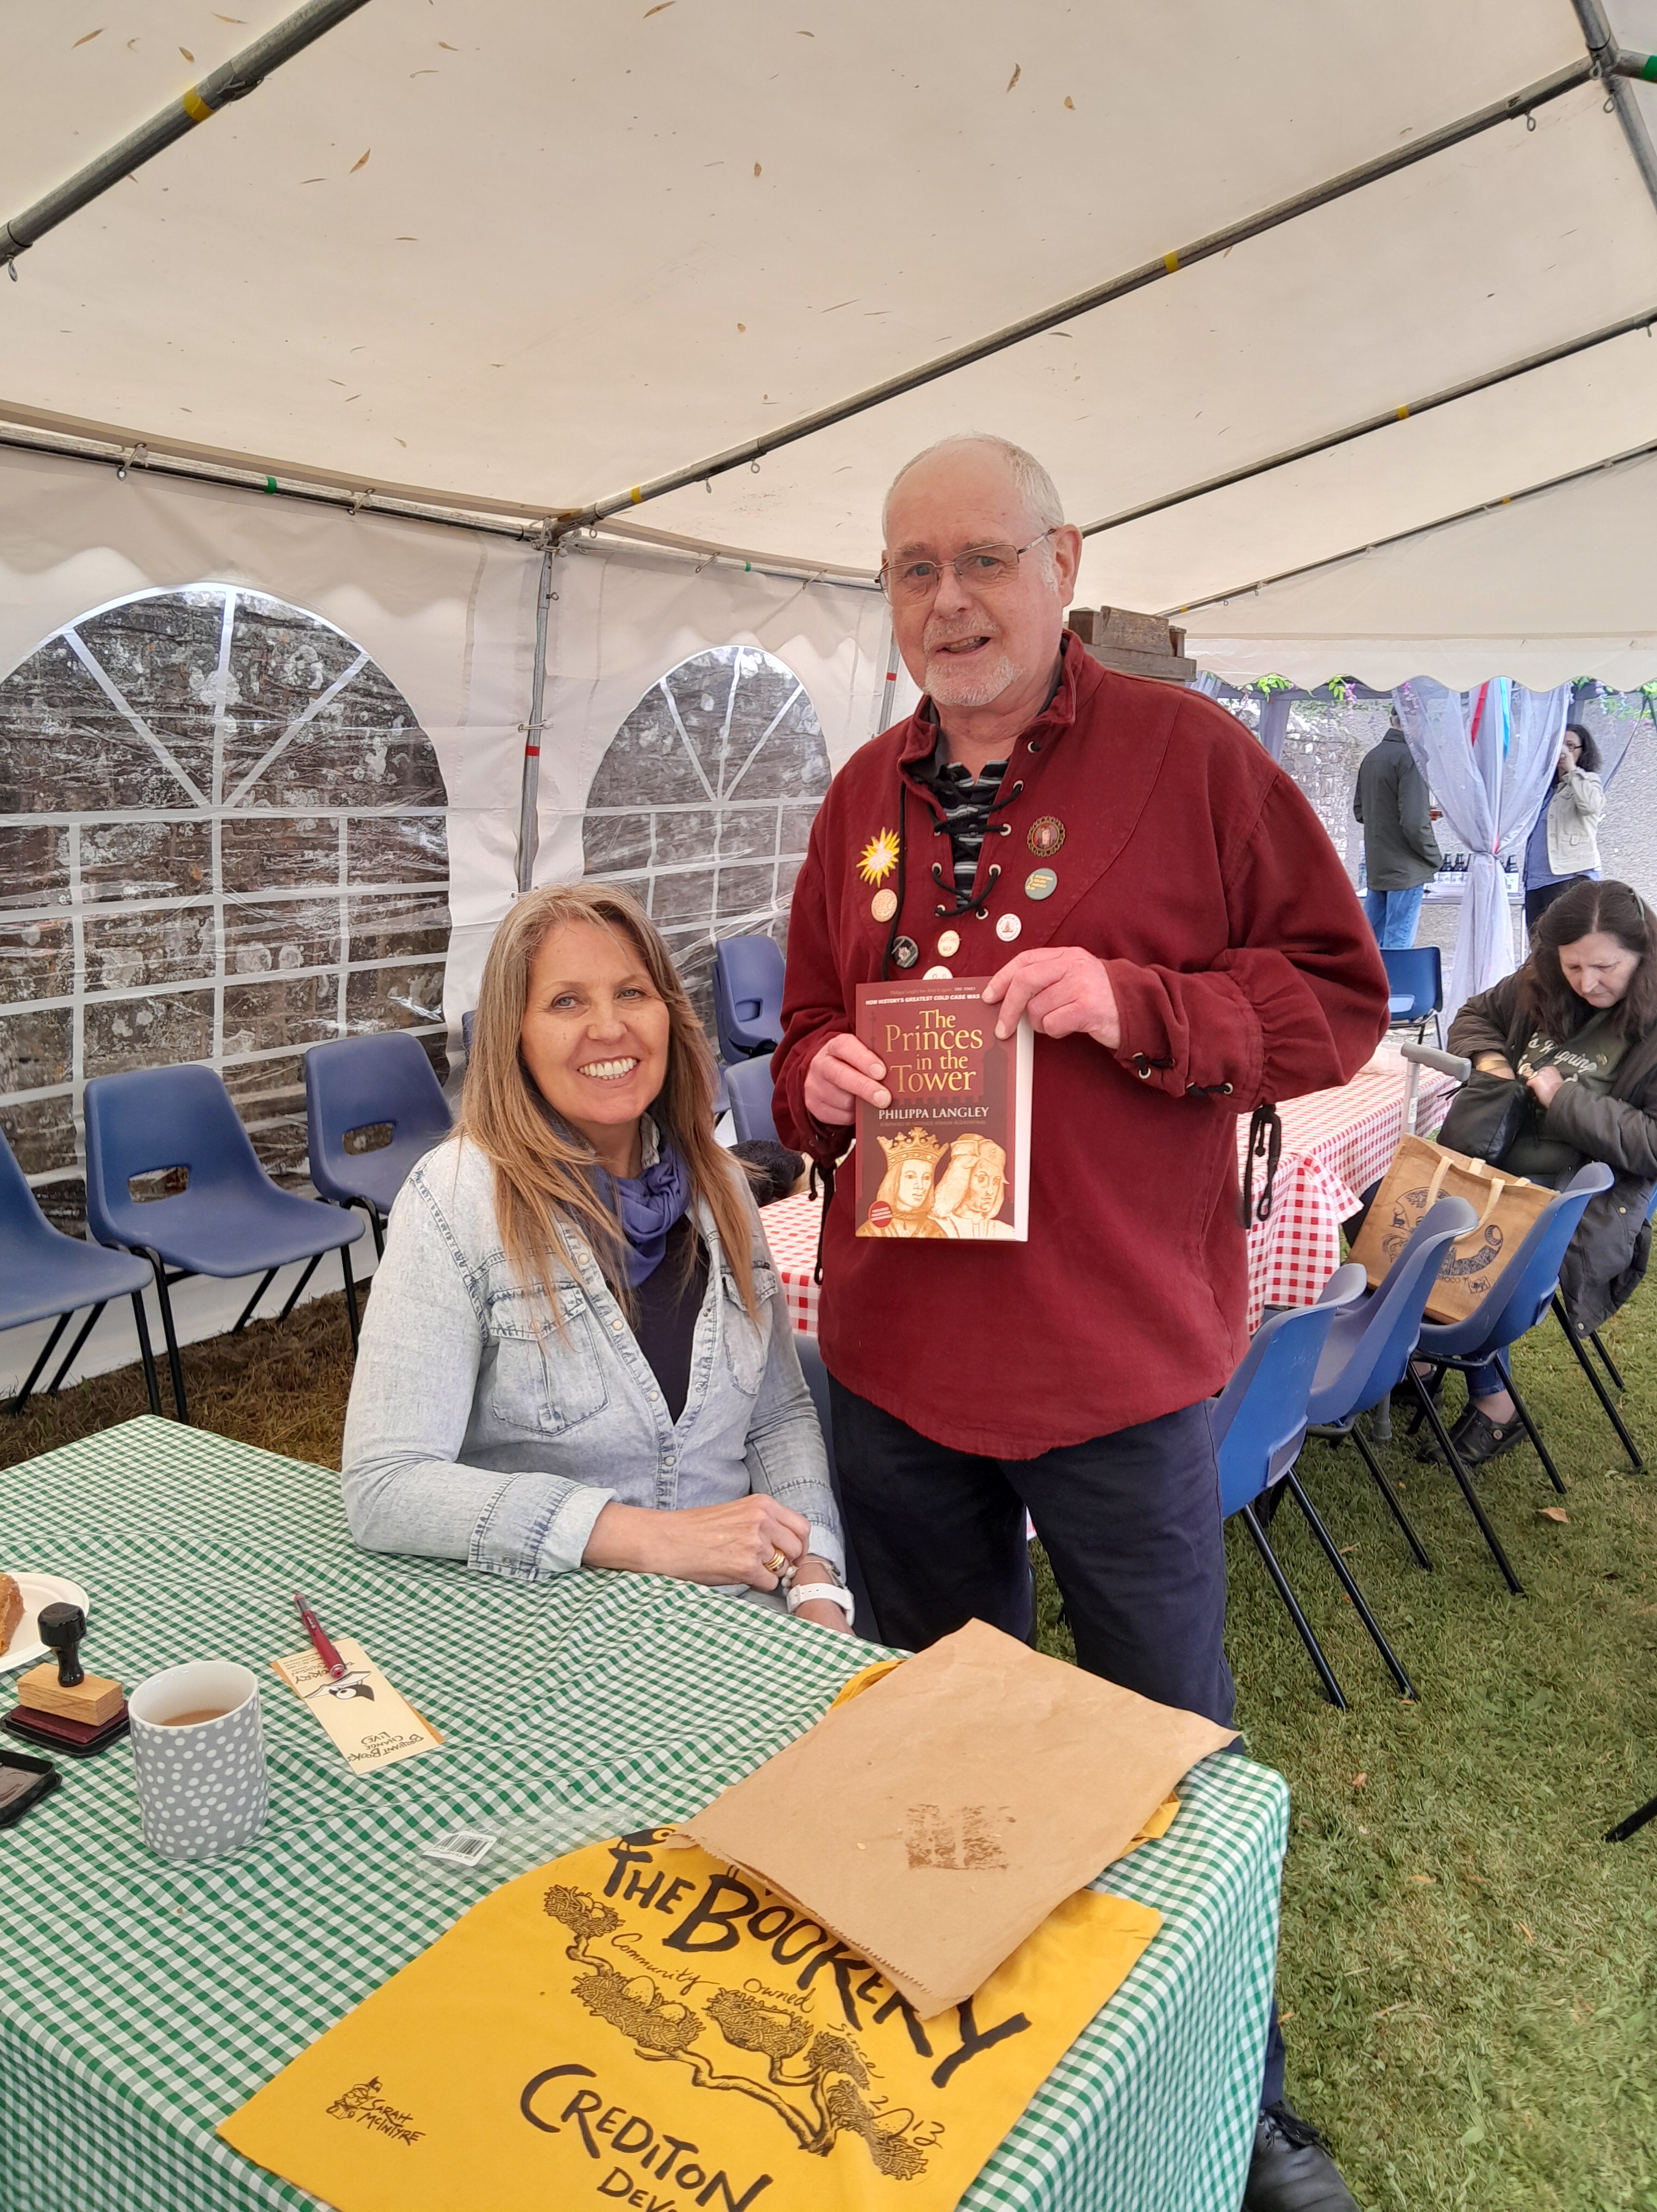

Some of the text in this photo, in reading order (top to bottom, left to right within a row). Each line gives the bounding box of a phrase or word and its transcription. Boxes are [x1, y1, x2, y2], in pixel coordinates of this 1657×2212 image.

[919, 1008, 956, 1029] The
[884, 1024, 983, 1052] Princes
[916, 1050, 968, 1070] in the
[890, 1064, 977, 1092] Tower
[878, 1107, 990, 1120] PHILIPPA LANGLEY
[295, 1669, 329, 1684] OKERY
[346, 1733, 424, 1762] BRILLIANT BOOKS
[361, 1731, 390, 1746] LIVES
[366, 1735, 403, 1751] CHANGE
[603, 1847, 696, 1914] THE
[611, 1932, 816, 2013] Community Owned
[360, 2099, 414, 2127] SARAH
[520, 2063, 774, 2212] CREDITON
[597, 2166, 678, 2212] DEV
